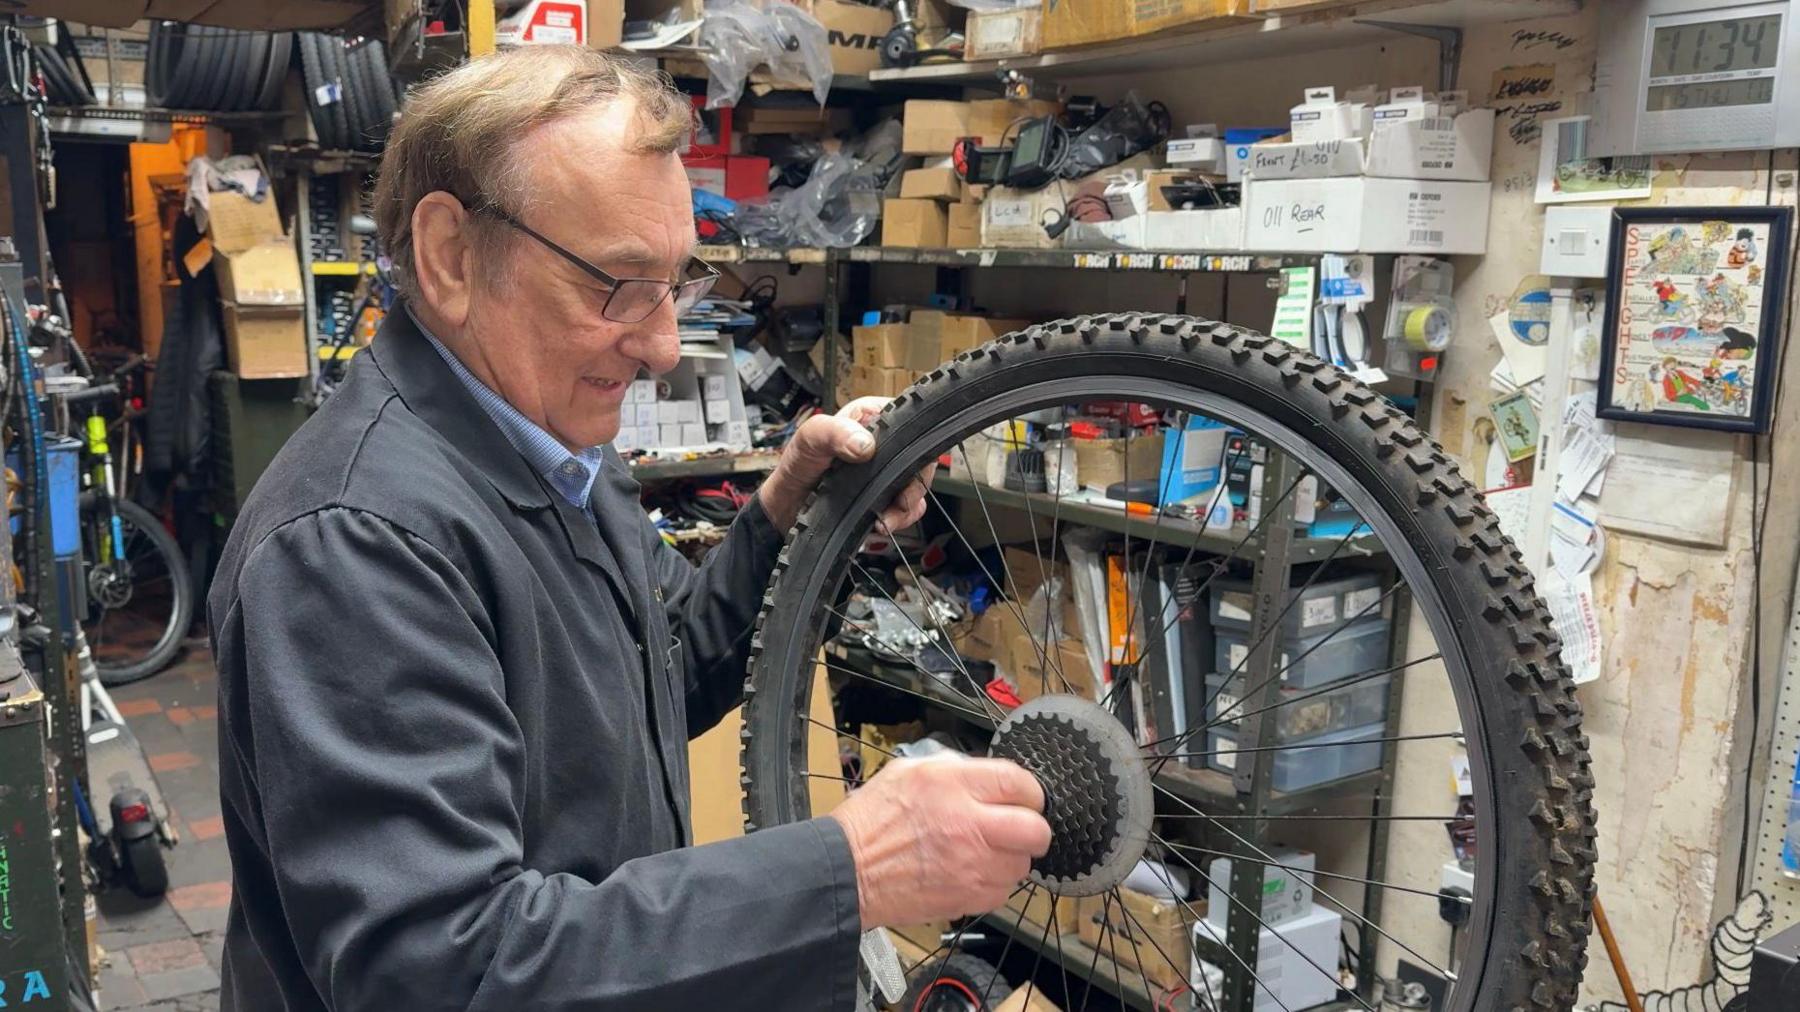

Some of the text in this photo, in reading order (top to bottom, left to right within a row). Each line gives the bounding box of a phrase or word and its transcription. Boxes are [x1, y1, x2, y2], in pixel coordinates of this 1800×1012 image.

[1073, 254, 1110, 269] TORCH
[1115, 253, 1155, 269] TORCH
[1159, 253, 1200, 270] TORCH
[1206, 255, 1252, 271] TORCH
